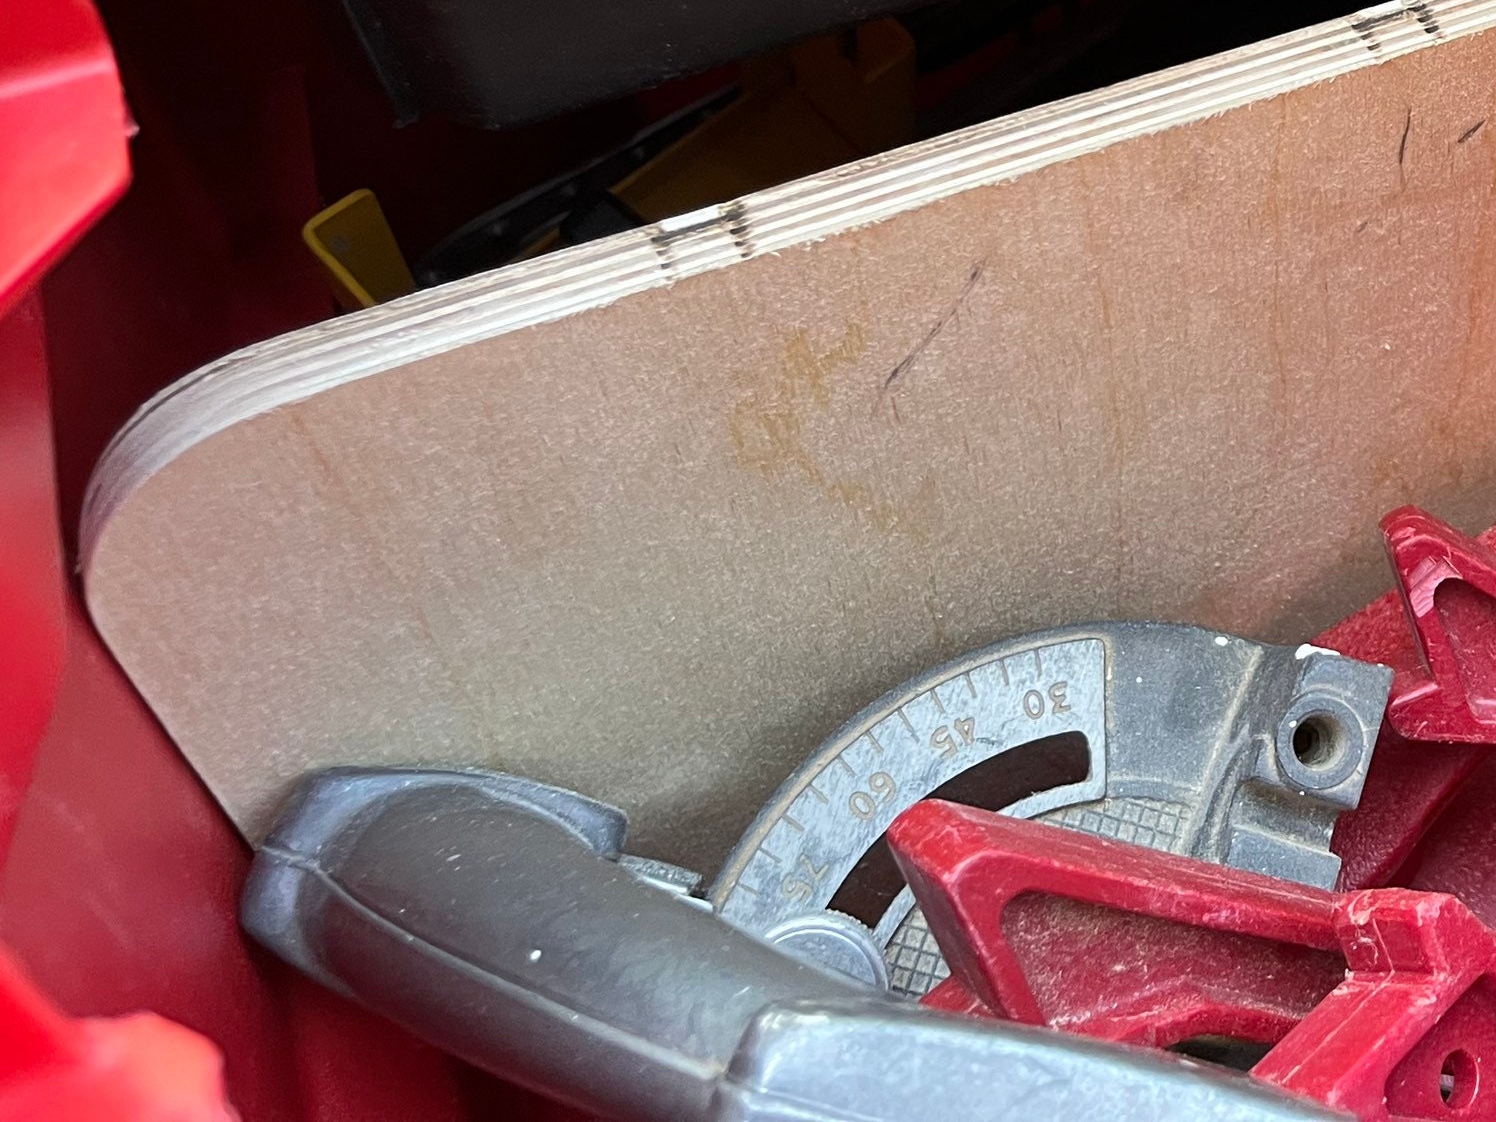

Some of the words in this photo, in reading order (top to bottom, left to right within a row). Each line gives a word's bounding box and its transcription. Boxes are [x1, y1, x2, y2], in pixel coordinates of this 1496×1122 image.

[1022, 679, 1073, 721] 30
[928, 715, 977, 759] 45
[847, 770, 898, 822] 60
[779, 854, 831, 901] 75
